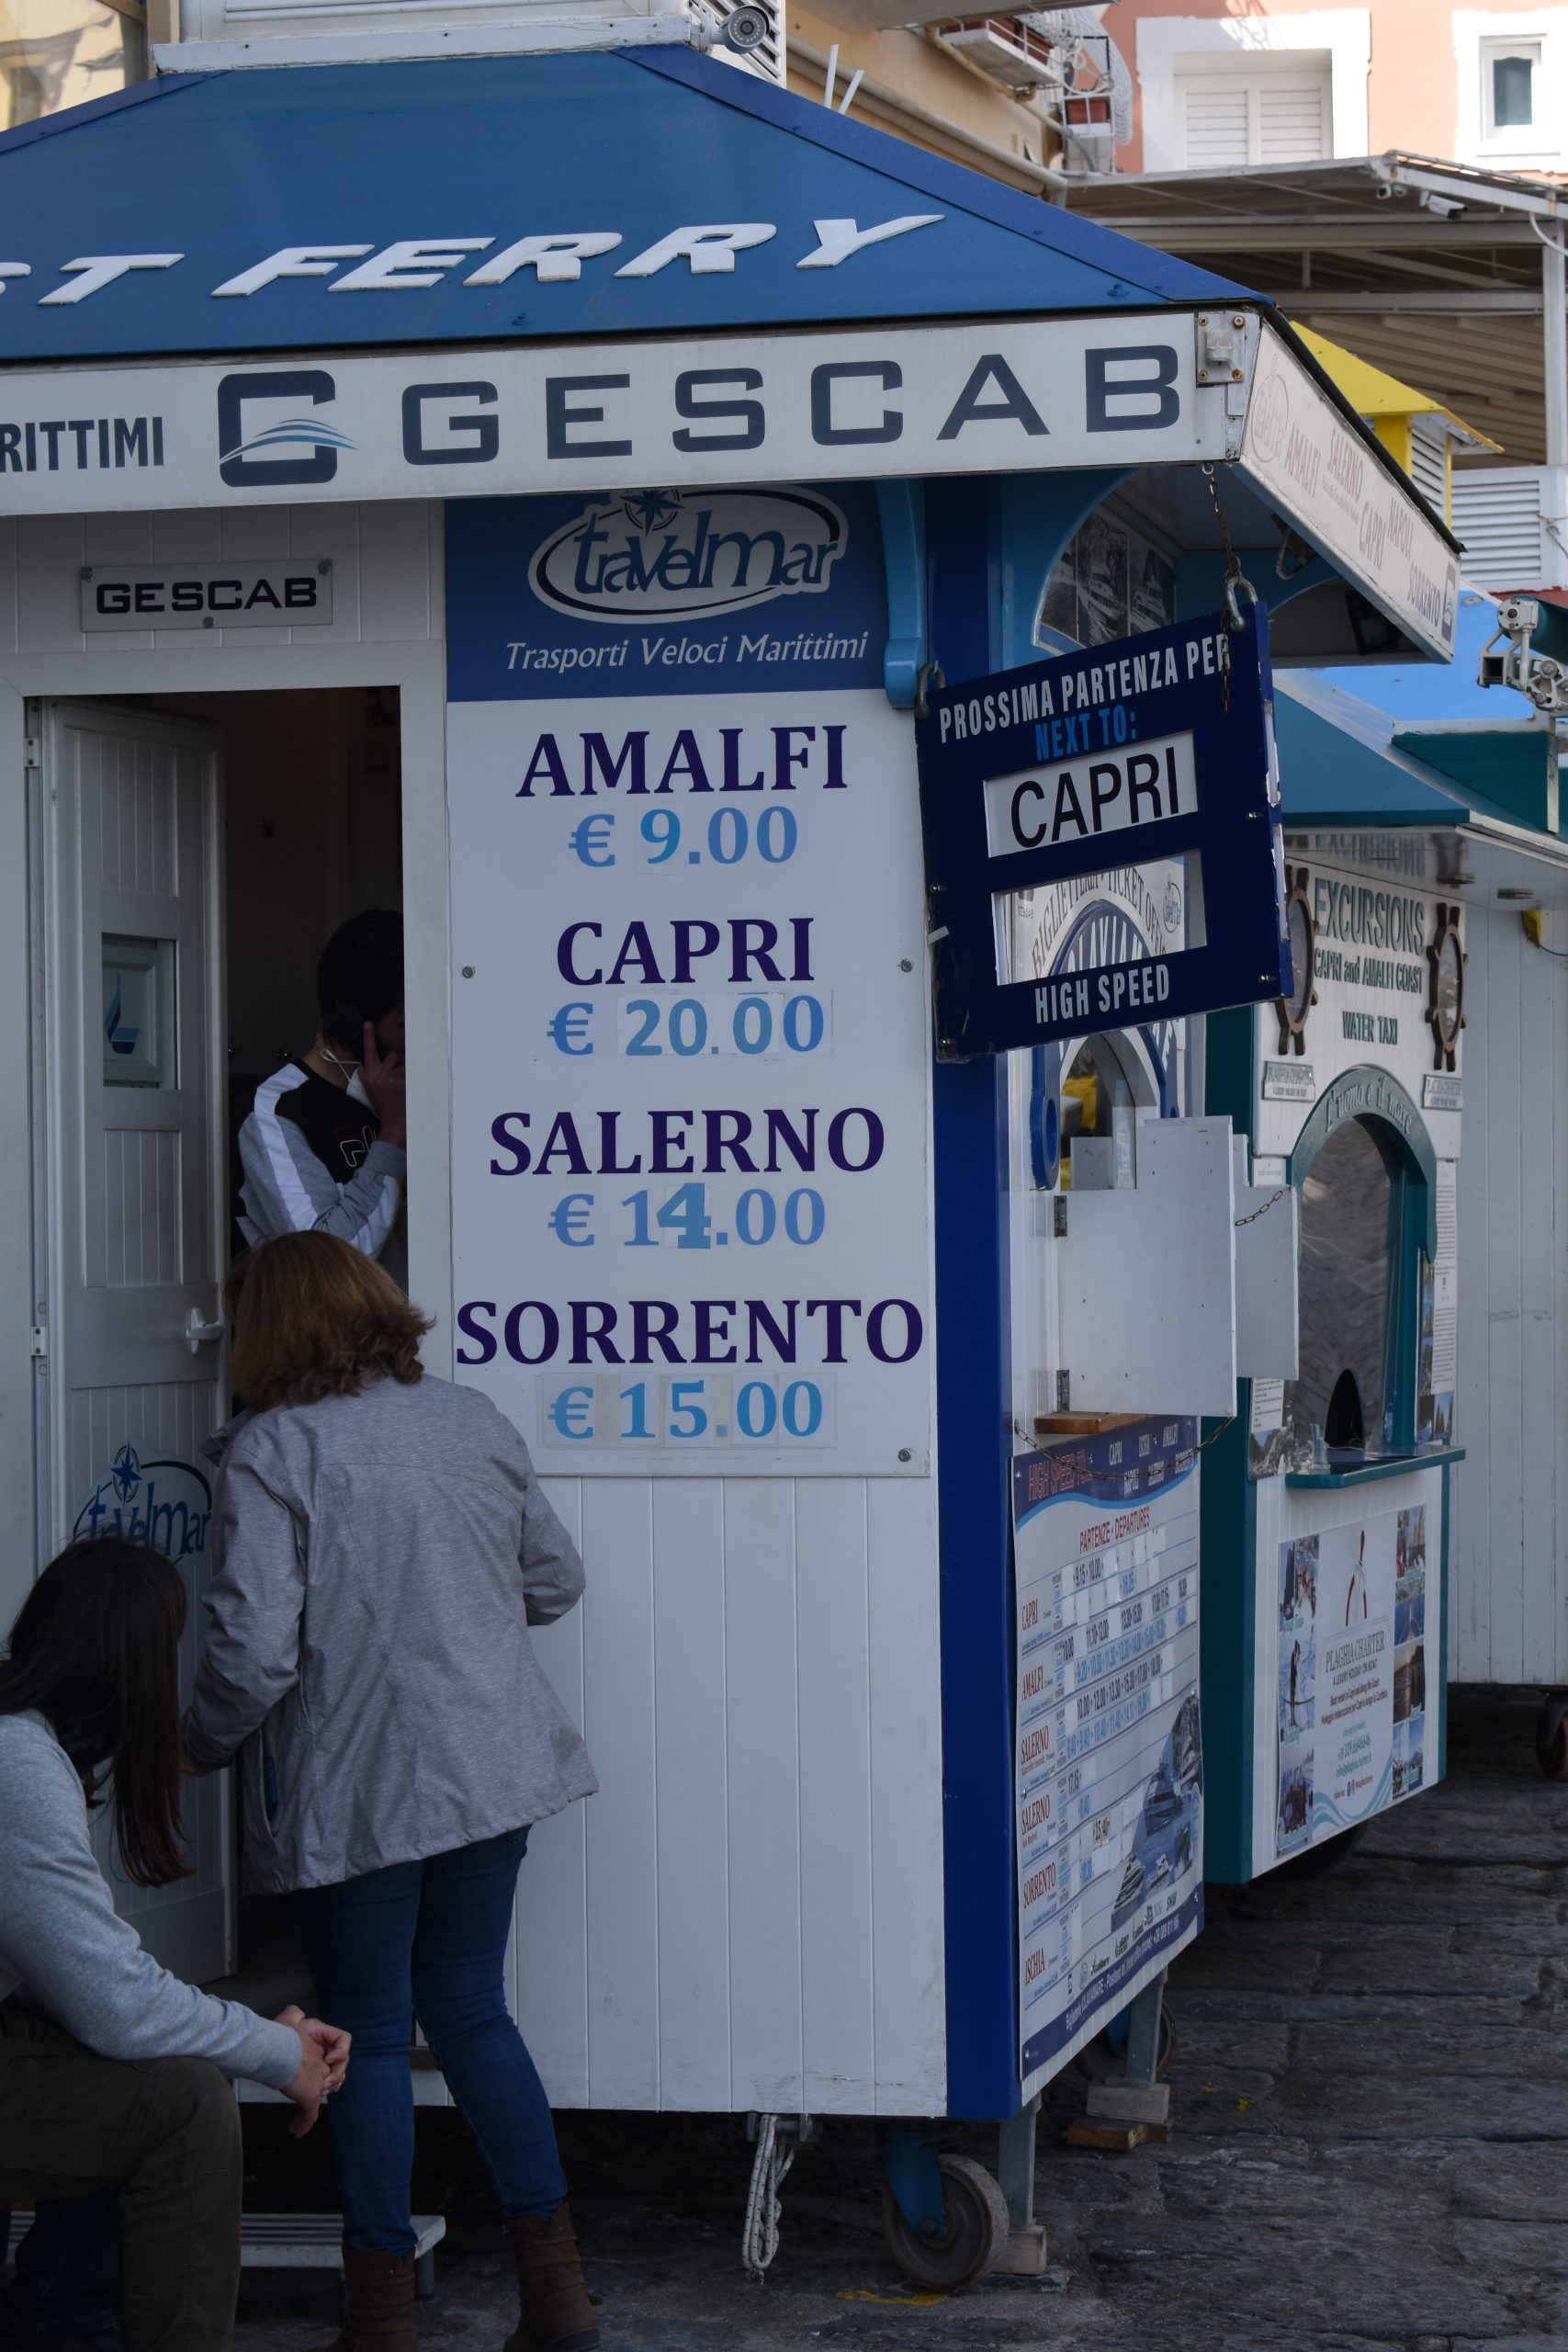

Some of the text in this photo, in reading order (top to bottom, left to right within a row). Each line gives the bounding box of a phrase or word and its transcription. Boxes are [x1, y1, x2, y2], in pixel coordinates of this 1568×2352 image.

[210, 215, 946, 297] FERRY
[401, 345, 1180, 466] GESCAB
[96, 576, 319, 615] GESCAB
[506, 631, 869, 674] Trasporti Veloci Marittimi
[939, 680, 1055, 744] PROSSIMA
[1061, 646, 1179, 712] PARTENZA
[515, 725, 848, 797] AMALFI
[1035, 705, 1137, 762] NEXT TO:
[1010, 747, 1179, 849] CAPRI
[569, 806, 798, 867] € 9.00
[1314, 876, 1425, 957] EXCURSIONS
[557, 917, 815, 986] CAPRI
[1314, 947, 1424, 995] CAPRI and AMALFI COAST
[1034, 964, 1170, 1024] HIGH SPEED
[547, 995, 824, 1057] € 20.00
[1342, 1011, 1398, 1046] WATER TAXI
[490, 1107, 885, 1176] SALERNO
[1388, 1092, 1413, 1135] mare
[547, 1182, 826, 1250] € 14.00
[457, 1298, 924, 1365] SORRENTO
[547, 1380, 823, 1440] € 15.00
[1109, 1441, 1122, 1465] CAPRI
[1080, 1507, 1150, 1554] PARTENZE DEPARTURES
[1021, 1599, 1039, 1632] CAPRI
[1325, 1630, 1385, 1673] PLAGHIA CHARTER
[1021, 1665, 1043, 1702] AMALFI
[1021, 1725, 1049, 1766] SALERNO
[1021, 1794, 1050, 1836] SALERNO
[1023, 1861, 1055, 1909] SORRENTO
[1025, 1946, 1045, 1985] ISCHIA
